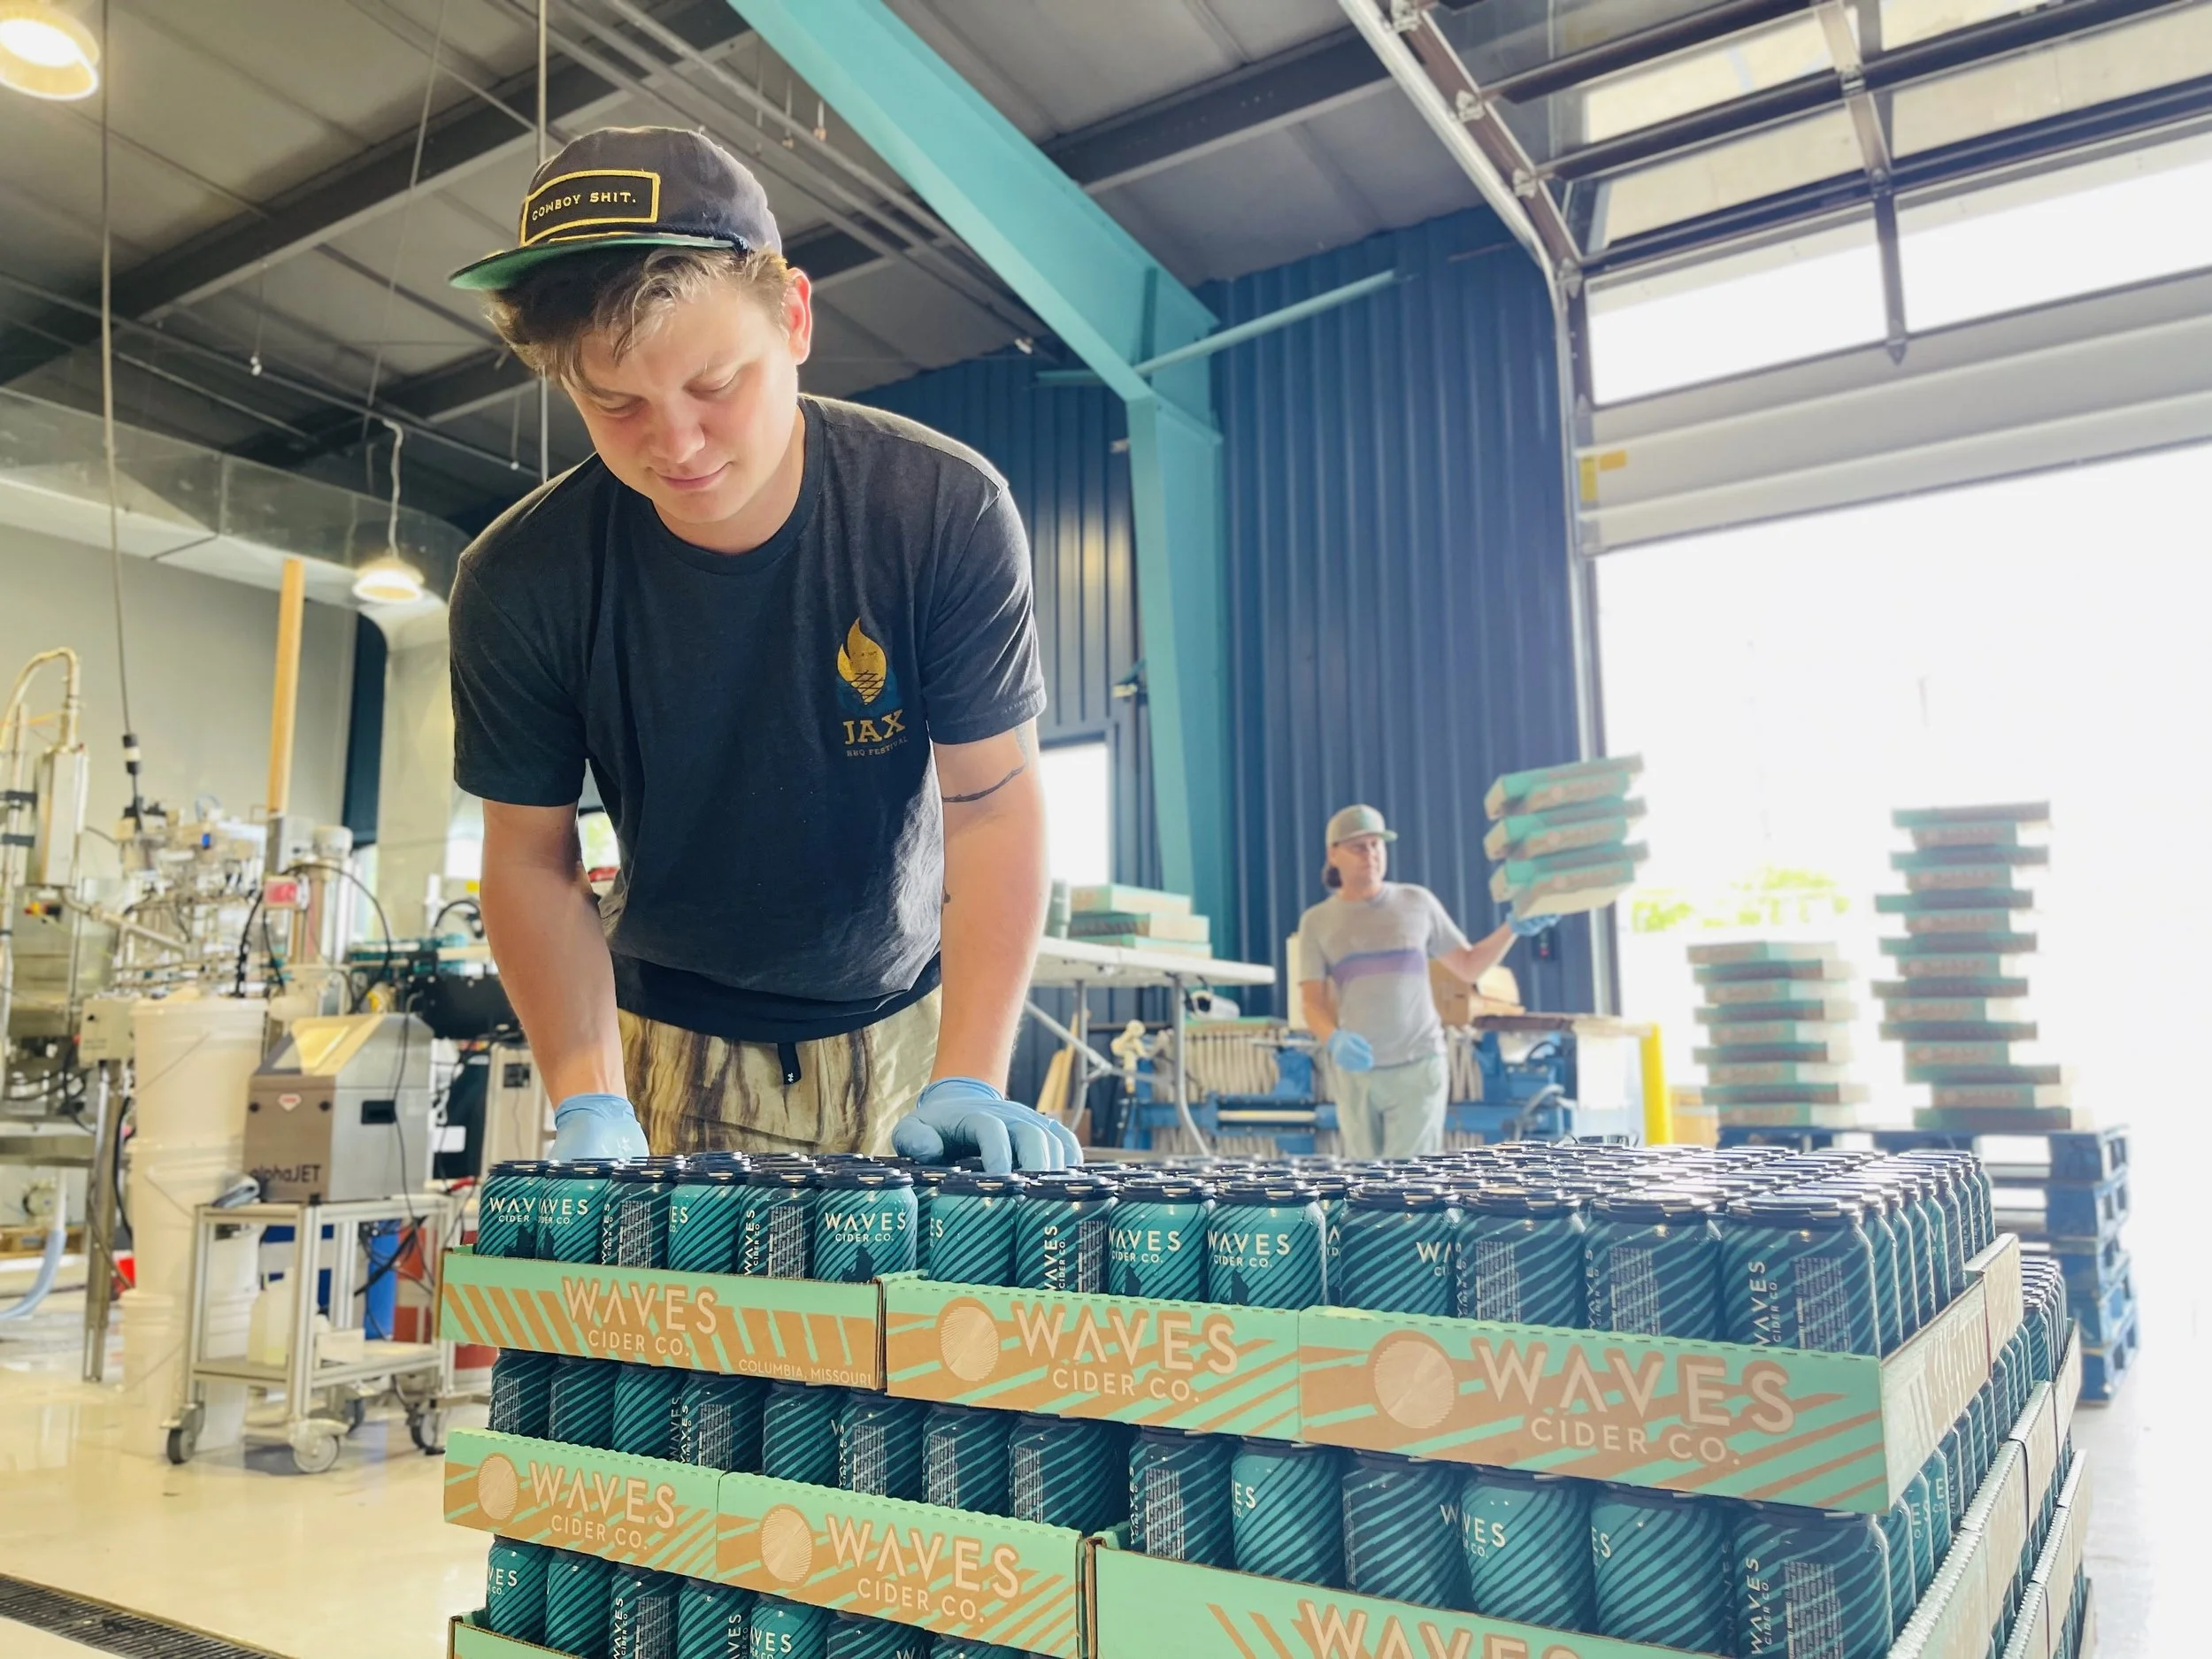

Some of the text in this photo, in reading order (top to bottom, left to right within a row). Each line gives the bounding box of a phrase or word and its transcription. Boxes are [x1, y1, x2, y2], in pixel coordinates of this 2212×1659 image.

[532, 191, 636, 221] COWBOY SHIT.
[842, 709, 906, 745] JAX
[869, 735, 909, 756] FESTIVAL
[669, 1205, 688, 1224] ES
[825, 1211, 906, 1232] WAVES
[744, 1210, 755, 1276] WAVES
[835, 1233, 894, 1242] CIDER CO.
[1207, 1230, 1290, 1256] WAVES
[1111, 1250, 1164, 1264] CIDER CO.
[1213, 1255, 1272, 1269] CIDER CO.
[564, 1279, 718, 1334] WAVES
[1770, 1305, 1782, 1343] CIDER
[588, 1329, 690, 1358] CIDER CO.
[1016, 1309, 1238, 1375] WAVES
[738, 1359, 872, 1386] COLUMBIA, MISSOURI
[1053, 1367, 1200, 1403] CIDER CO.
[1479, 1342, 1795, 1433] WAVES
[1531, 1417, 1740, 1465] CIDER CO.
[531, 1463, 675, 1529] WAVES
[1232, 1479, 1257, 1509] ES
[551, 1514, 648, 1550] CIDER CO.
[827, 1517, 1018, 1599] WAVES
[857, 1578, 984, 1624] CIDER CO.
[1746, 1557, 1763, 1655] WAVES
[1763, 1606, 1773, 1646] CIDER
